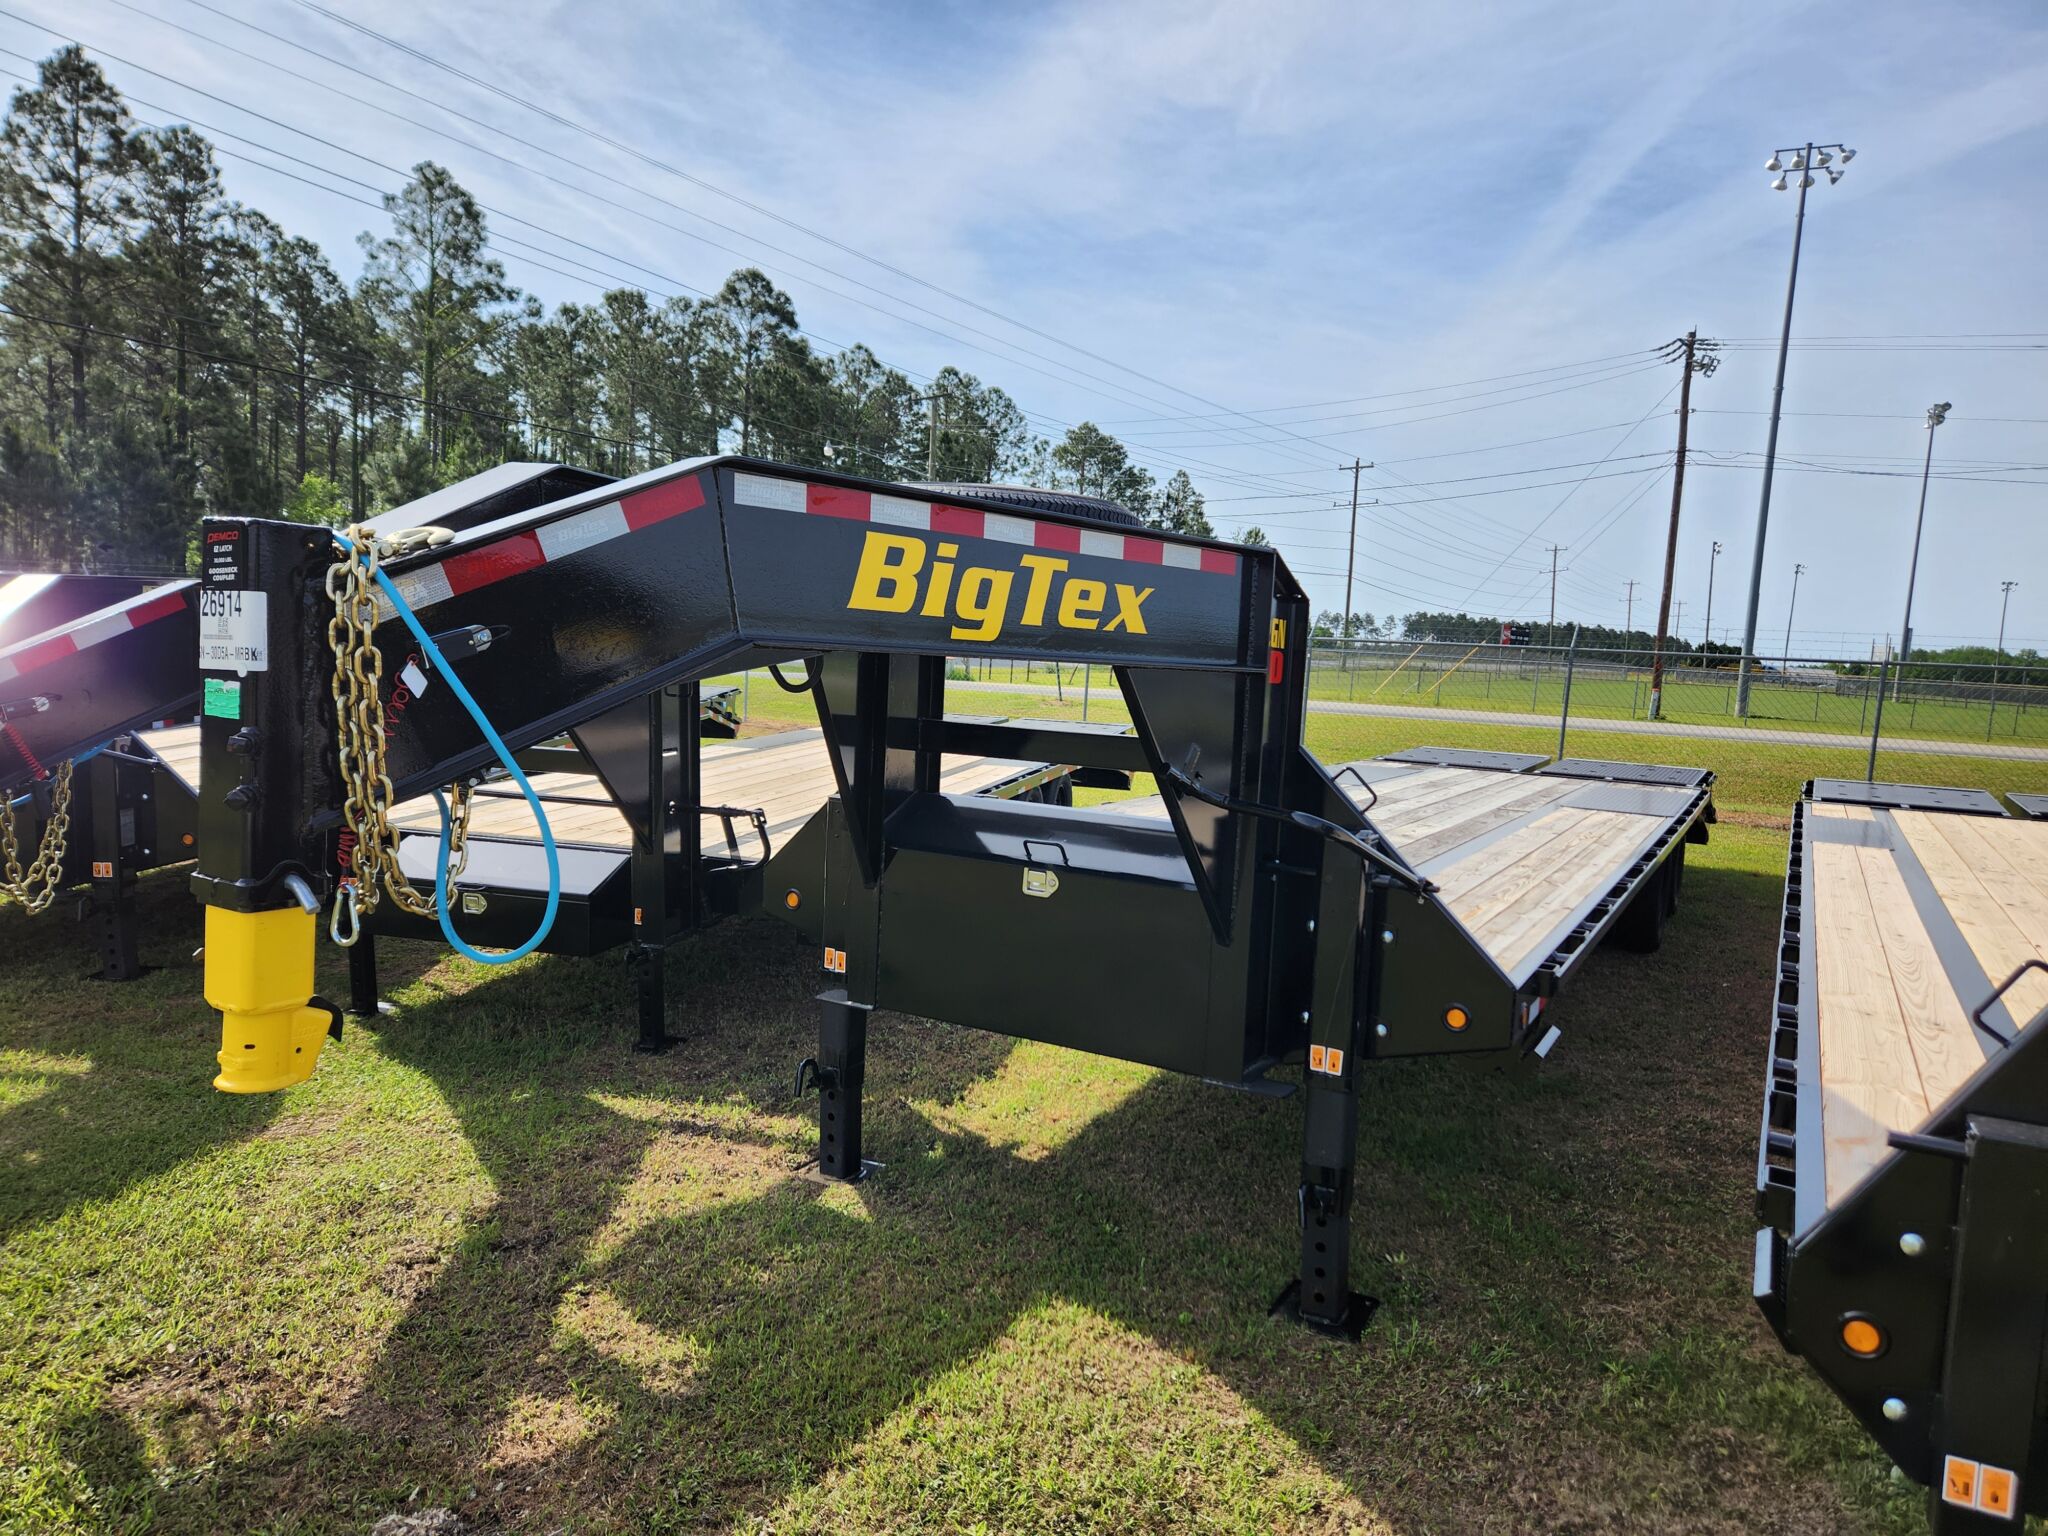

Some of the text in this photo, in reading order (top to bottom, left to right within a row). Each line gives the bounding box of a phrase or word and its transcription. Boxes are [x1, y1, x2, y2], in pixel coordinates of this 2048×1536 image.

[207, 531, 239, 544] DEMCO
[208, 566, 238, 574] GOOSENECK
[212, 573, 235, 581] COUPLER
[847, 531, 1155, 642] BigTex
[201, 589, 242, 617] 26914
